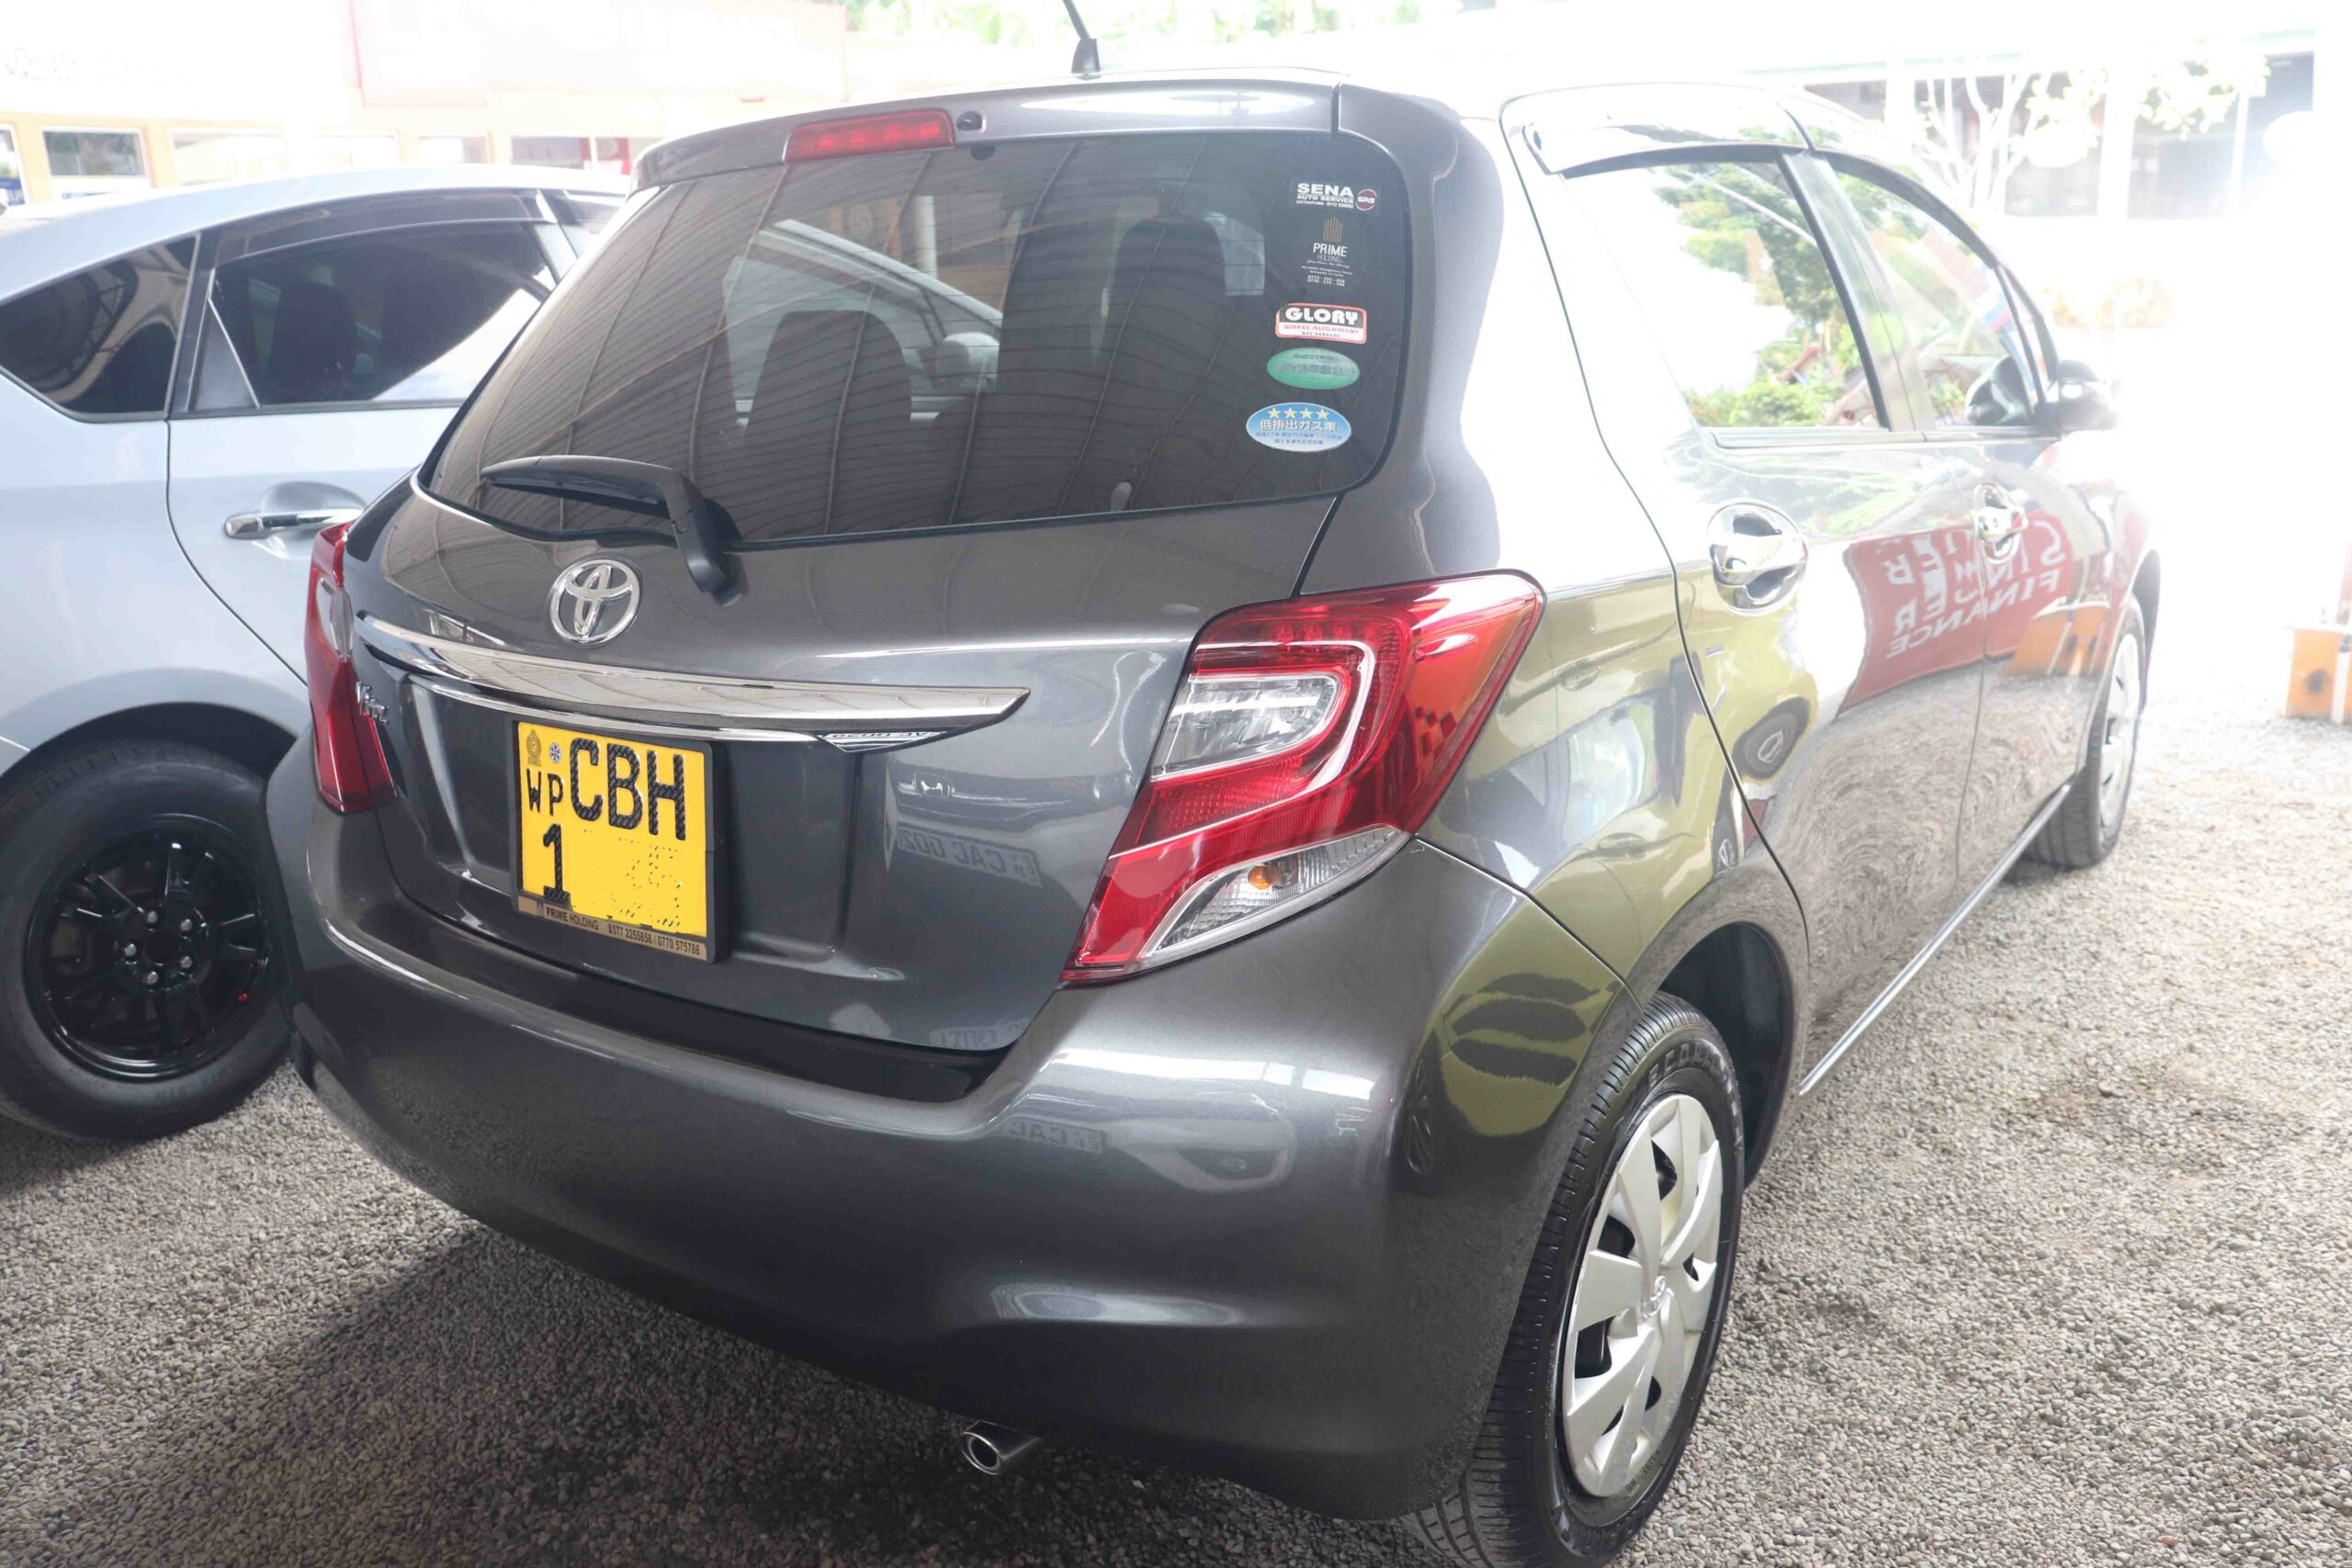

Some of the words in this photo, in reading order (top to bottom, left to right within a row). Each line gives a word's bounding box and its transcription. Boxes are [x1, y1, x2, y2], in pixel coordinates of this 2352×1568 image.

[1297, 183, 1354, 197] SENA
[1320, 196, 1354, 204] SERVICE
[1313, 243, 1348, 257] PRIME
[1285, 307, 1359, 325] GLORY
[1313, 325, 1359, 335] ALIGNMENT
[1260, 418, 1339, 433] 低排出ガス車
[526, 768, 564, 817] WP
[570, 737, 686, 840] CBH
[546, 906, 568, 921] PRIME
[570, 913, 599, 931] HOLDING
[657, 935, 674, 949] 0770
[675, 939, 700, 955] 575788
